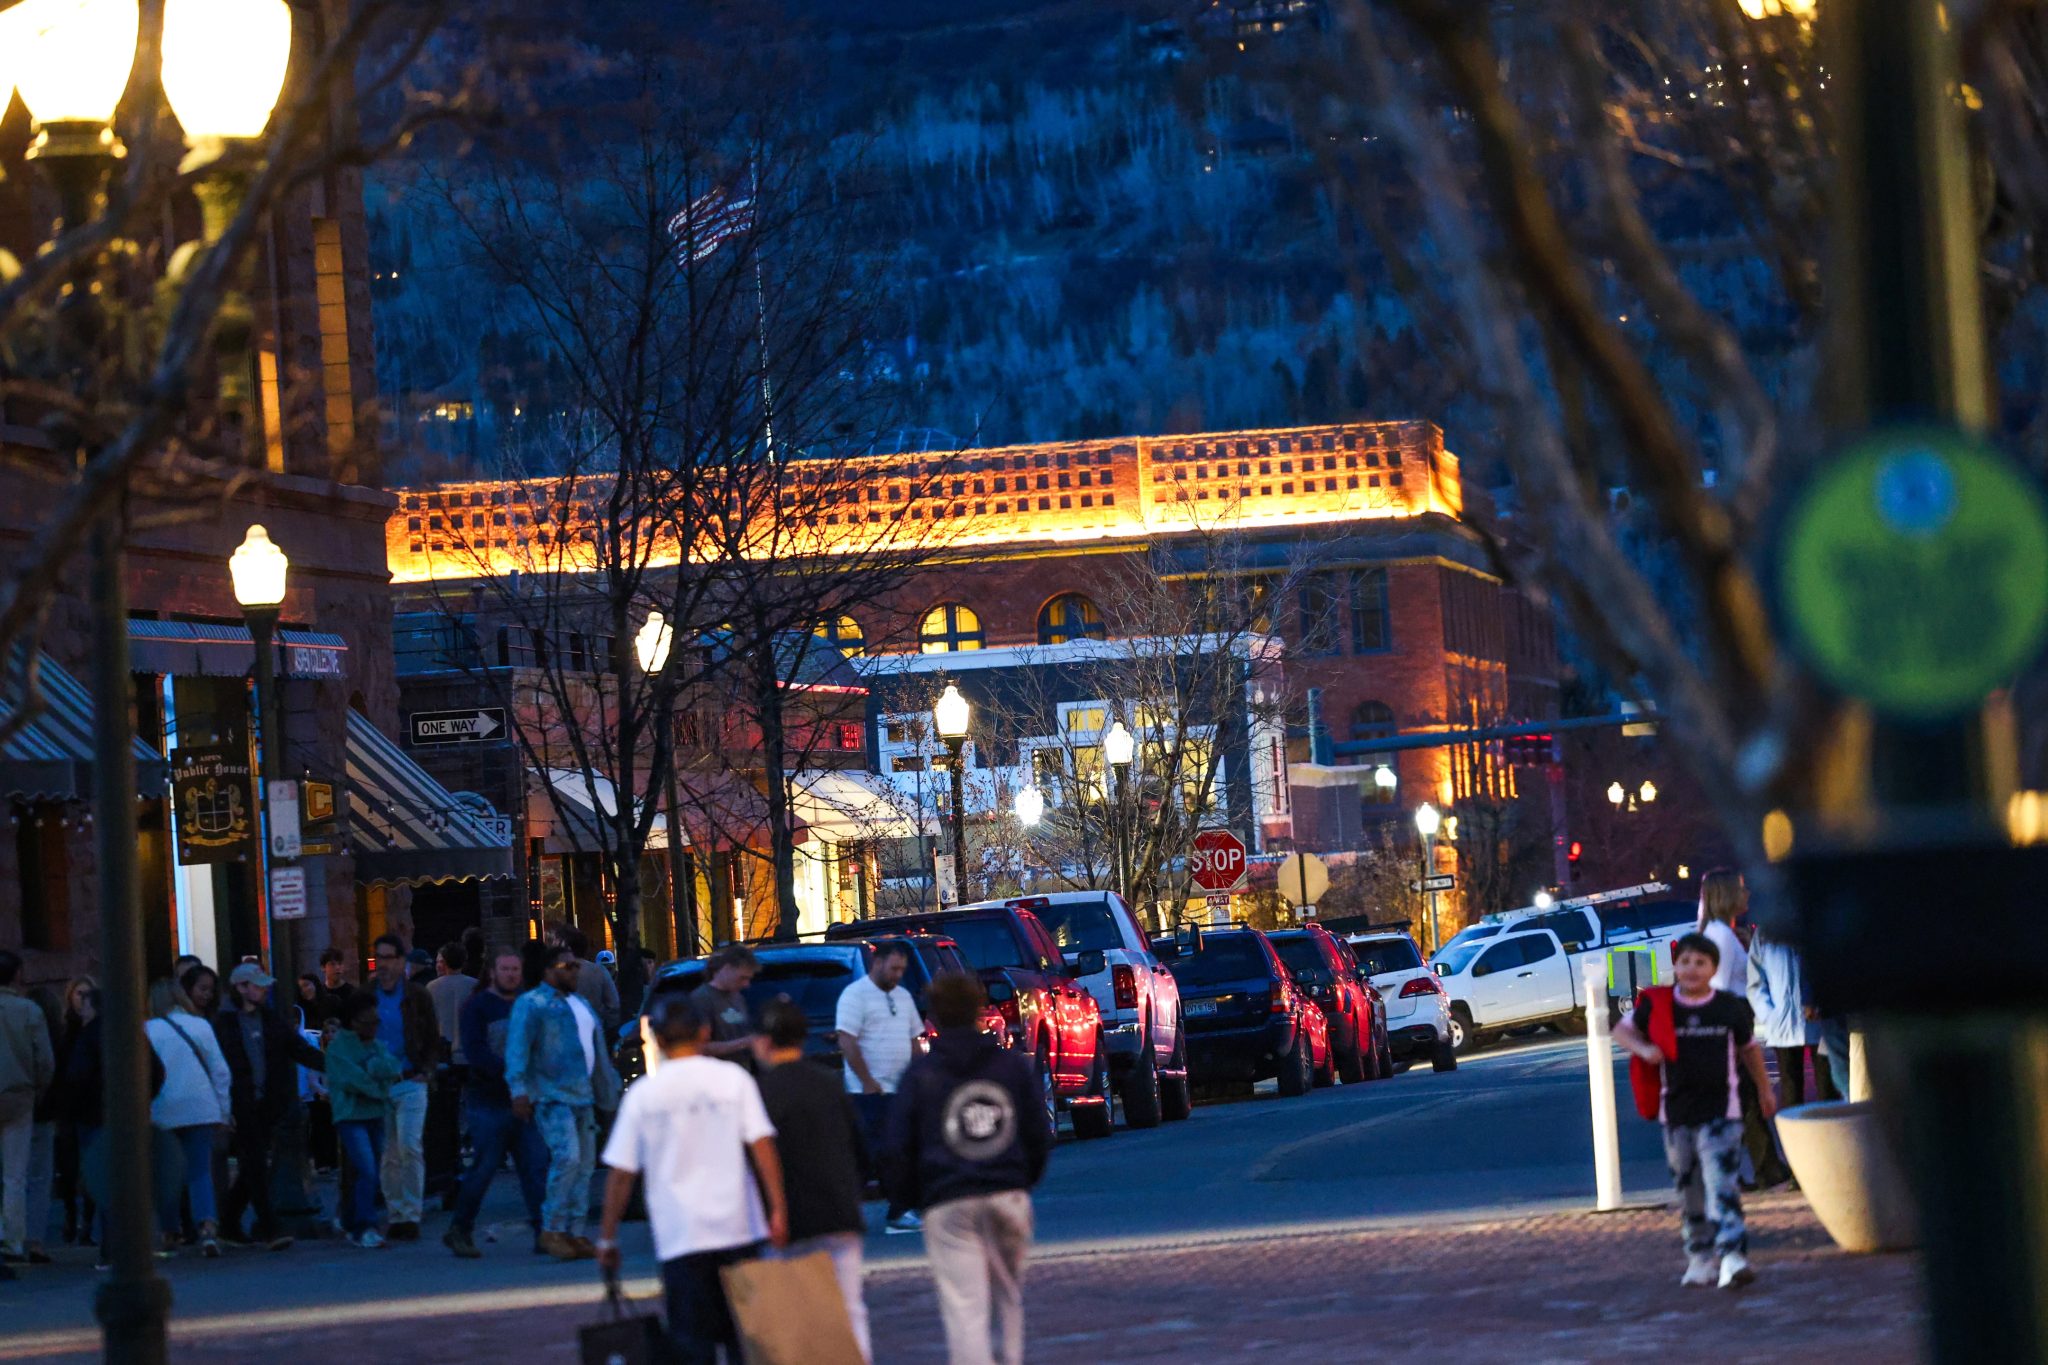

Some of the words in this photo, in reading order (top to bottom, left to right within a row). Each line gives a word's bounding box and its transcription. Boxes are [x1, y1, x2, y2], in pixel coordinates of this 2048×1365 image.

[421, 721, 446, 734] ONE
[450, 719, 477, 732] WAY
[200, 754, 222, 762] ASPEN
[174, 765, 209, 782] Public
[215, 762, 249, 777] House
[308, 784, 333, 817] C
[1191, 849, 1242, 872] STOP
